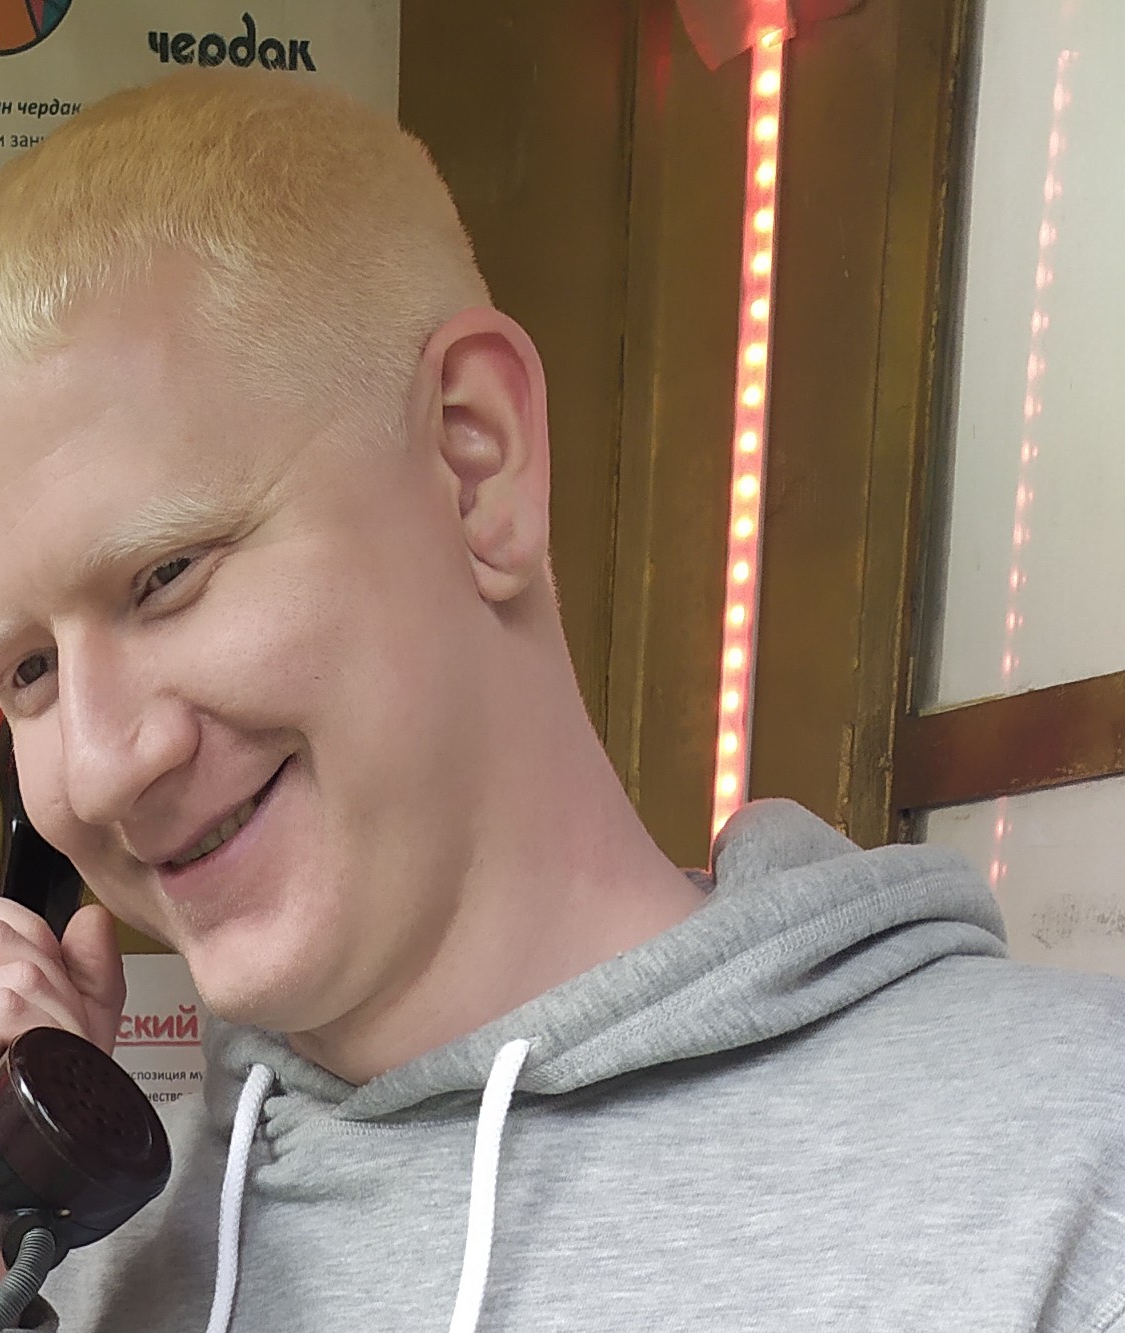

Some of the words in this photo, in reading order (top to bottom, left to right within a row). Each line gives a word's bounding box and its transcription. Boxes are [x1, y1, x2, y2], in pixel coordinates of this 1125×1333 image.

[148, 12, 316, 72] чердак
[17, 98, 82, 118] чердак
[128, 1071, 187, 1082] спозиция
